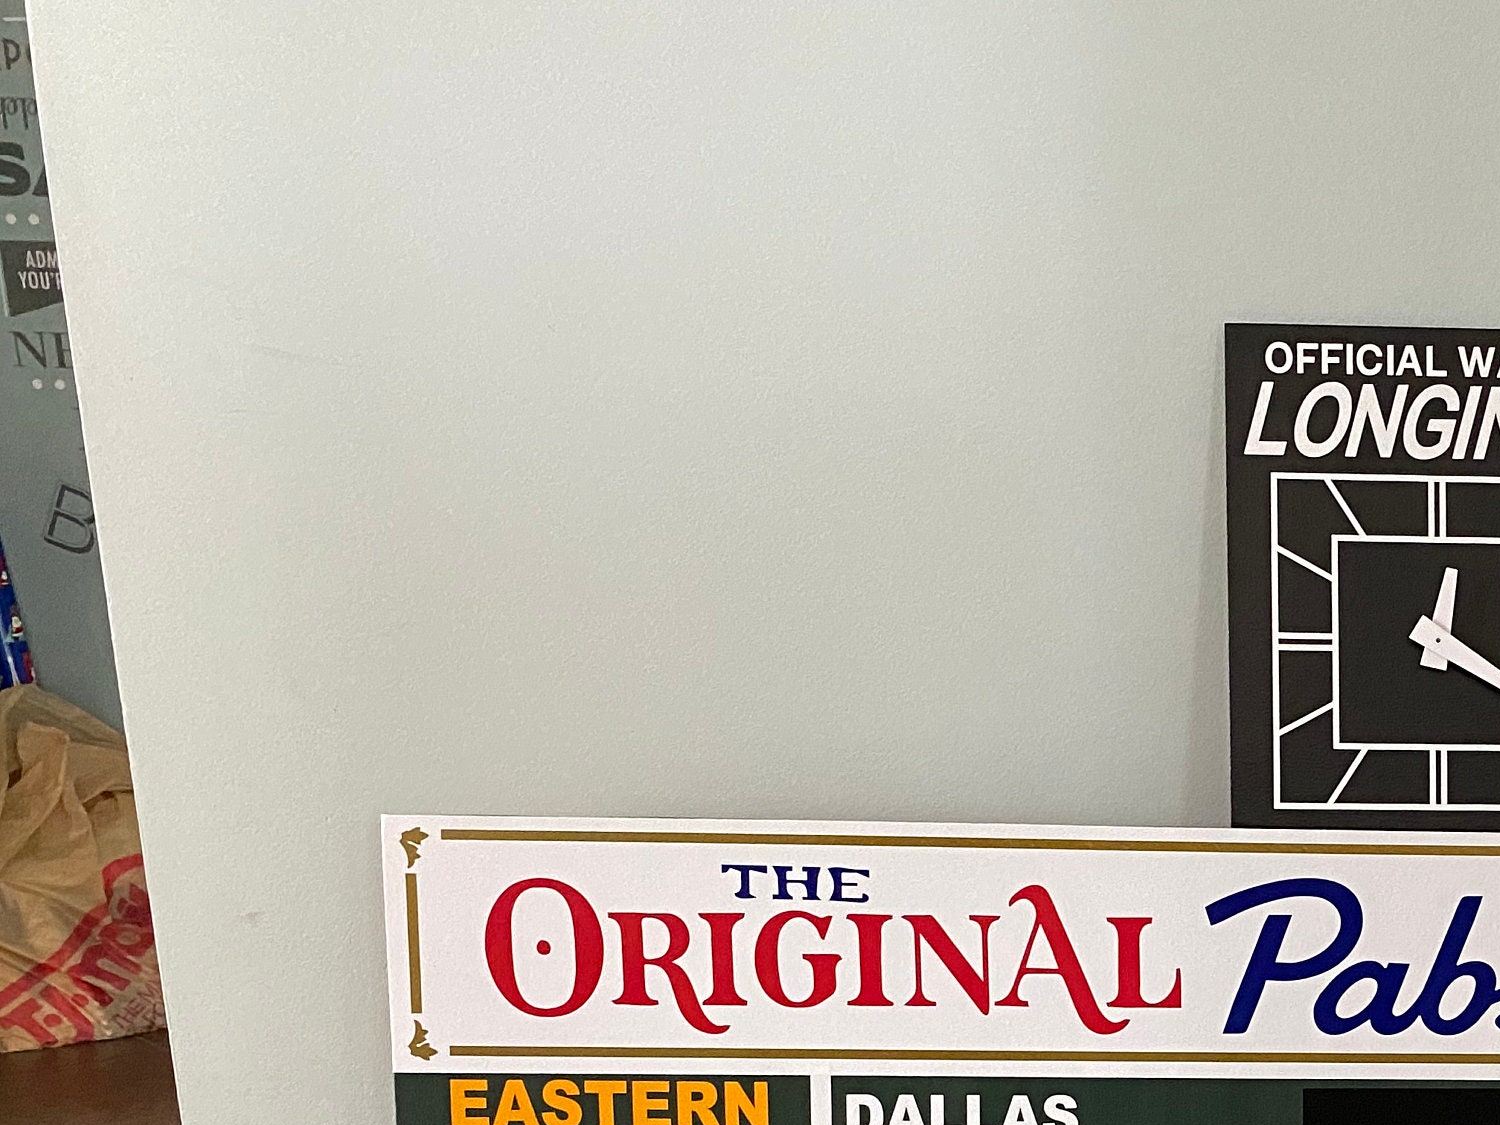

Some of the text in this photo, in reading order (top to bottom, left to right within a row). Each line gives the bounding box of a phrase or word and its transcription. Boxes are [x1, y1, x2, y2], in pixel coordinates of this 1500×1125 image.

[1264, 341, 1448, 378] OFFICIAL
[721, 864, 871, 903] THE
[484, 877, 1182, 1035] ORIGINAL
